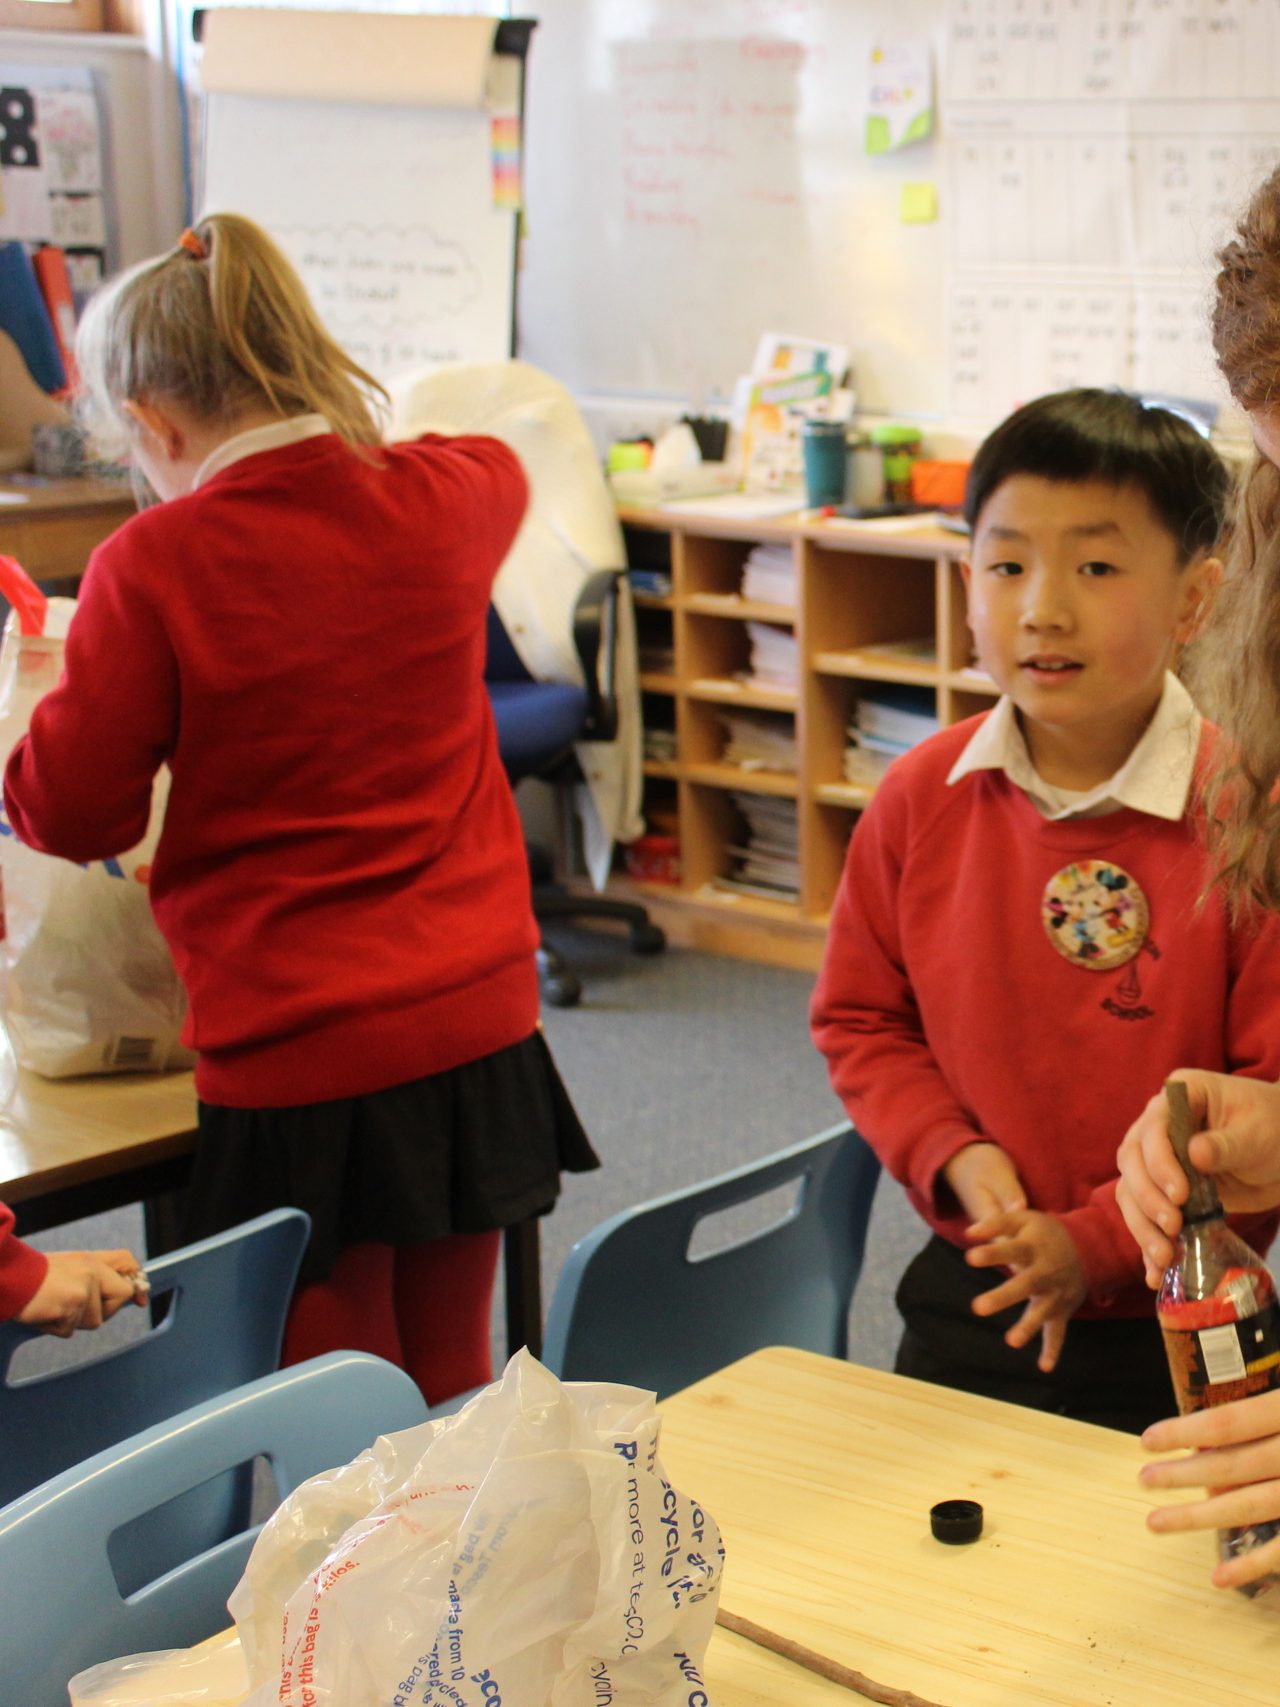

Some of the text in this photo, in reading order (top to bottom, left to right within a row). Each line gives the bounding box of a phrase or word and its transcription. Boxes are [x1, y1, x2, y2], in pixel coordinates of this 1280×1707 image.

[632, 1551, 646, 1578] at
[301, 1623, 321, 1654] bag
[448, 1628, 464, 1665] from
[298, 1654, 314, 1684] this
